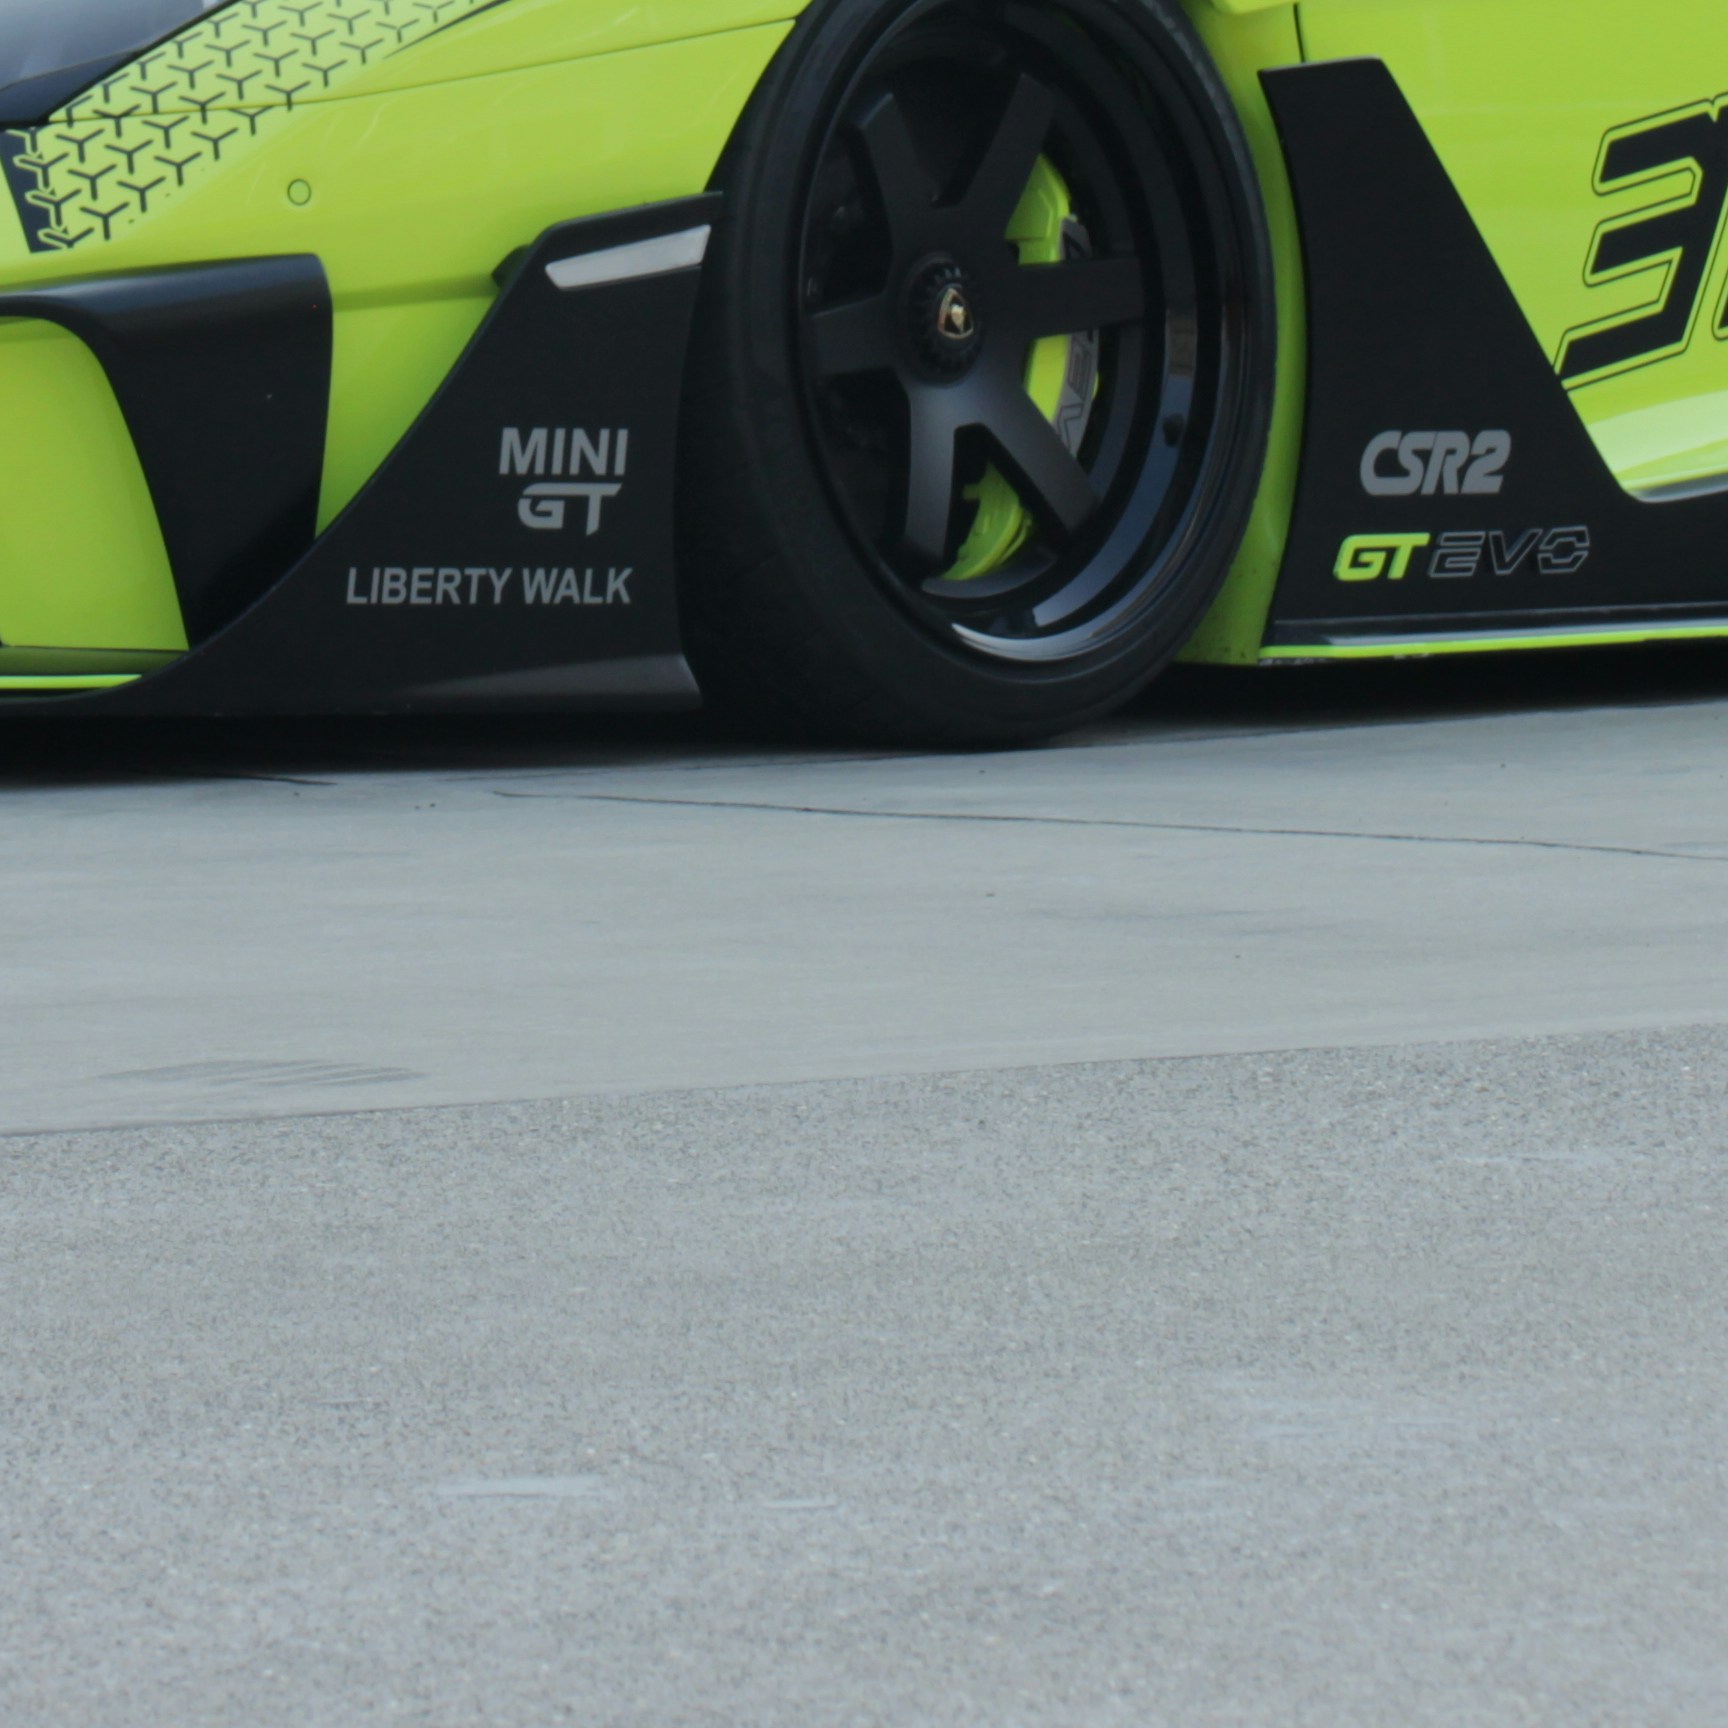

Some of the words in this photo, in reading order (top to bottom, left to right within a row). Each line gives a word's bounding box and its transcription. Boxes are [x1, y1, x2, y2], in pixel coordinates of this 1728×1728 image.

[499, 427, 629, 475] MINI
[1359, 429, 1512, 497] CSR2
[517, 482, 623, 536] GT
[1333, 532, 1430, 582] GT
[1427, 525, 1591, 579] EVO
[346, 566, 513, 605] LIBERTY
[522, 566, 634, 605] WALK
